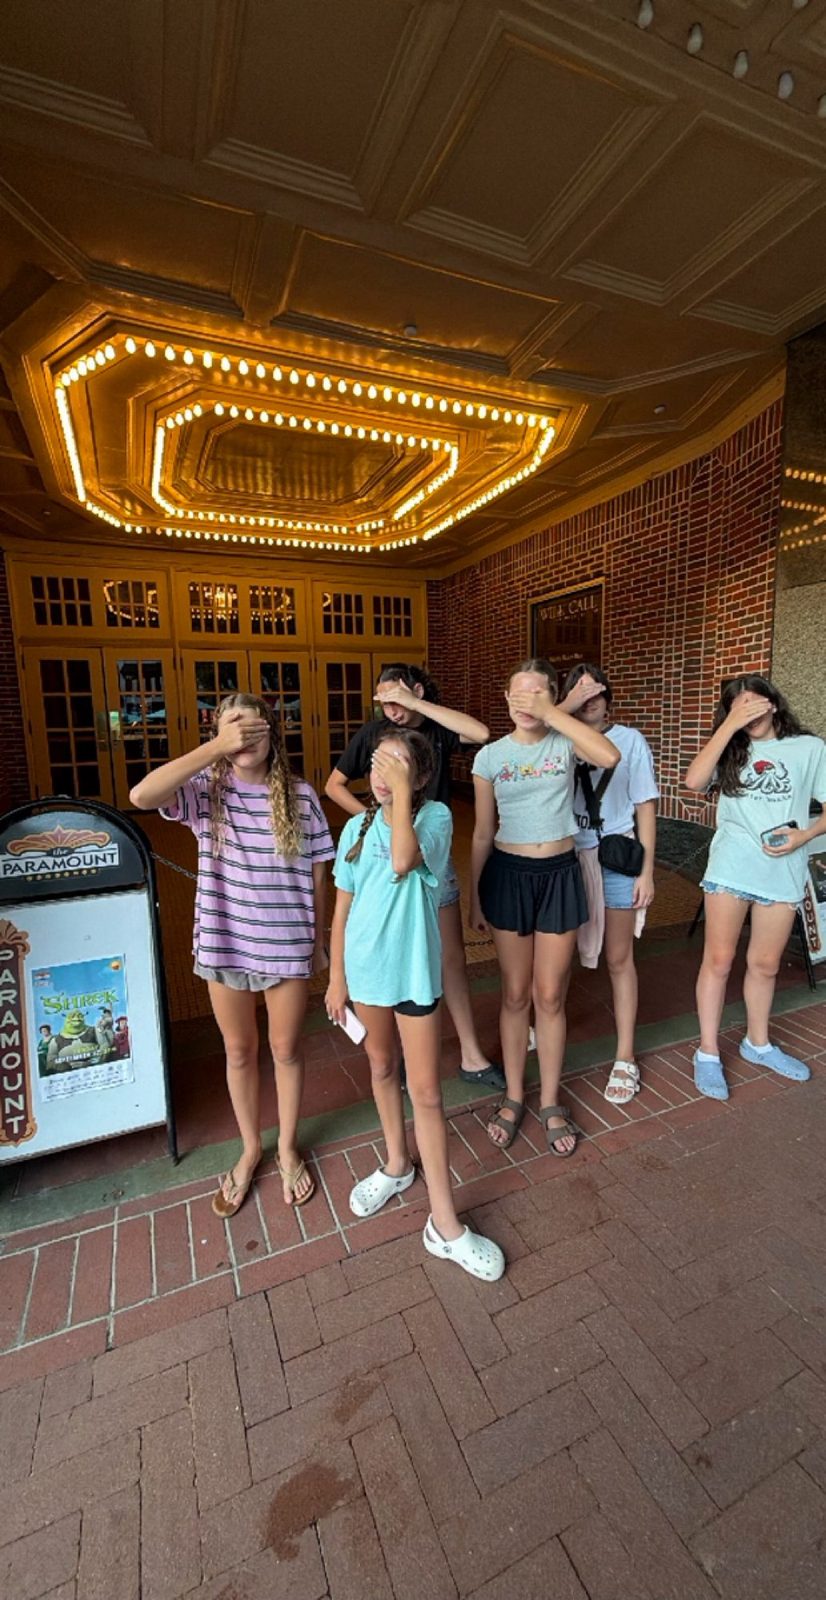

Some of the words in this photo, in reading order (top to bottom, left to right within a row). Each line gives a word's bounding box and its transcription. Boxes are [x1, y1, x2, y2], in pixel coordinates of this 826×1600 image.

[568, 595, 596, 614] CALL
[52, 848, 68, 856] the
[2, 852, 117, 876] PARAMOUNT
[41, 990, 119, 1015] SHREK
